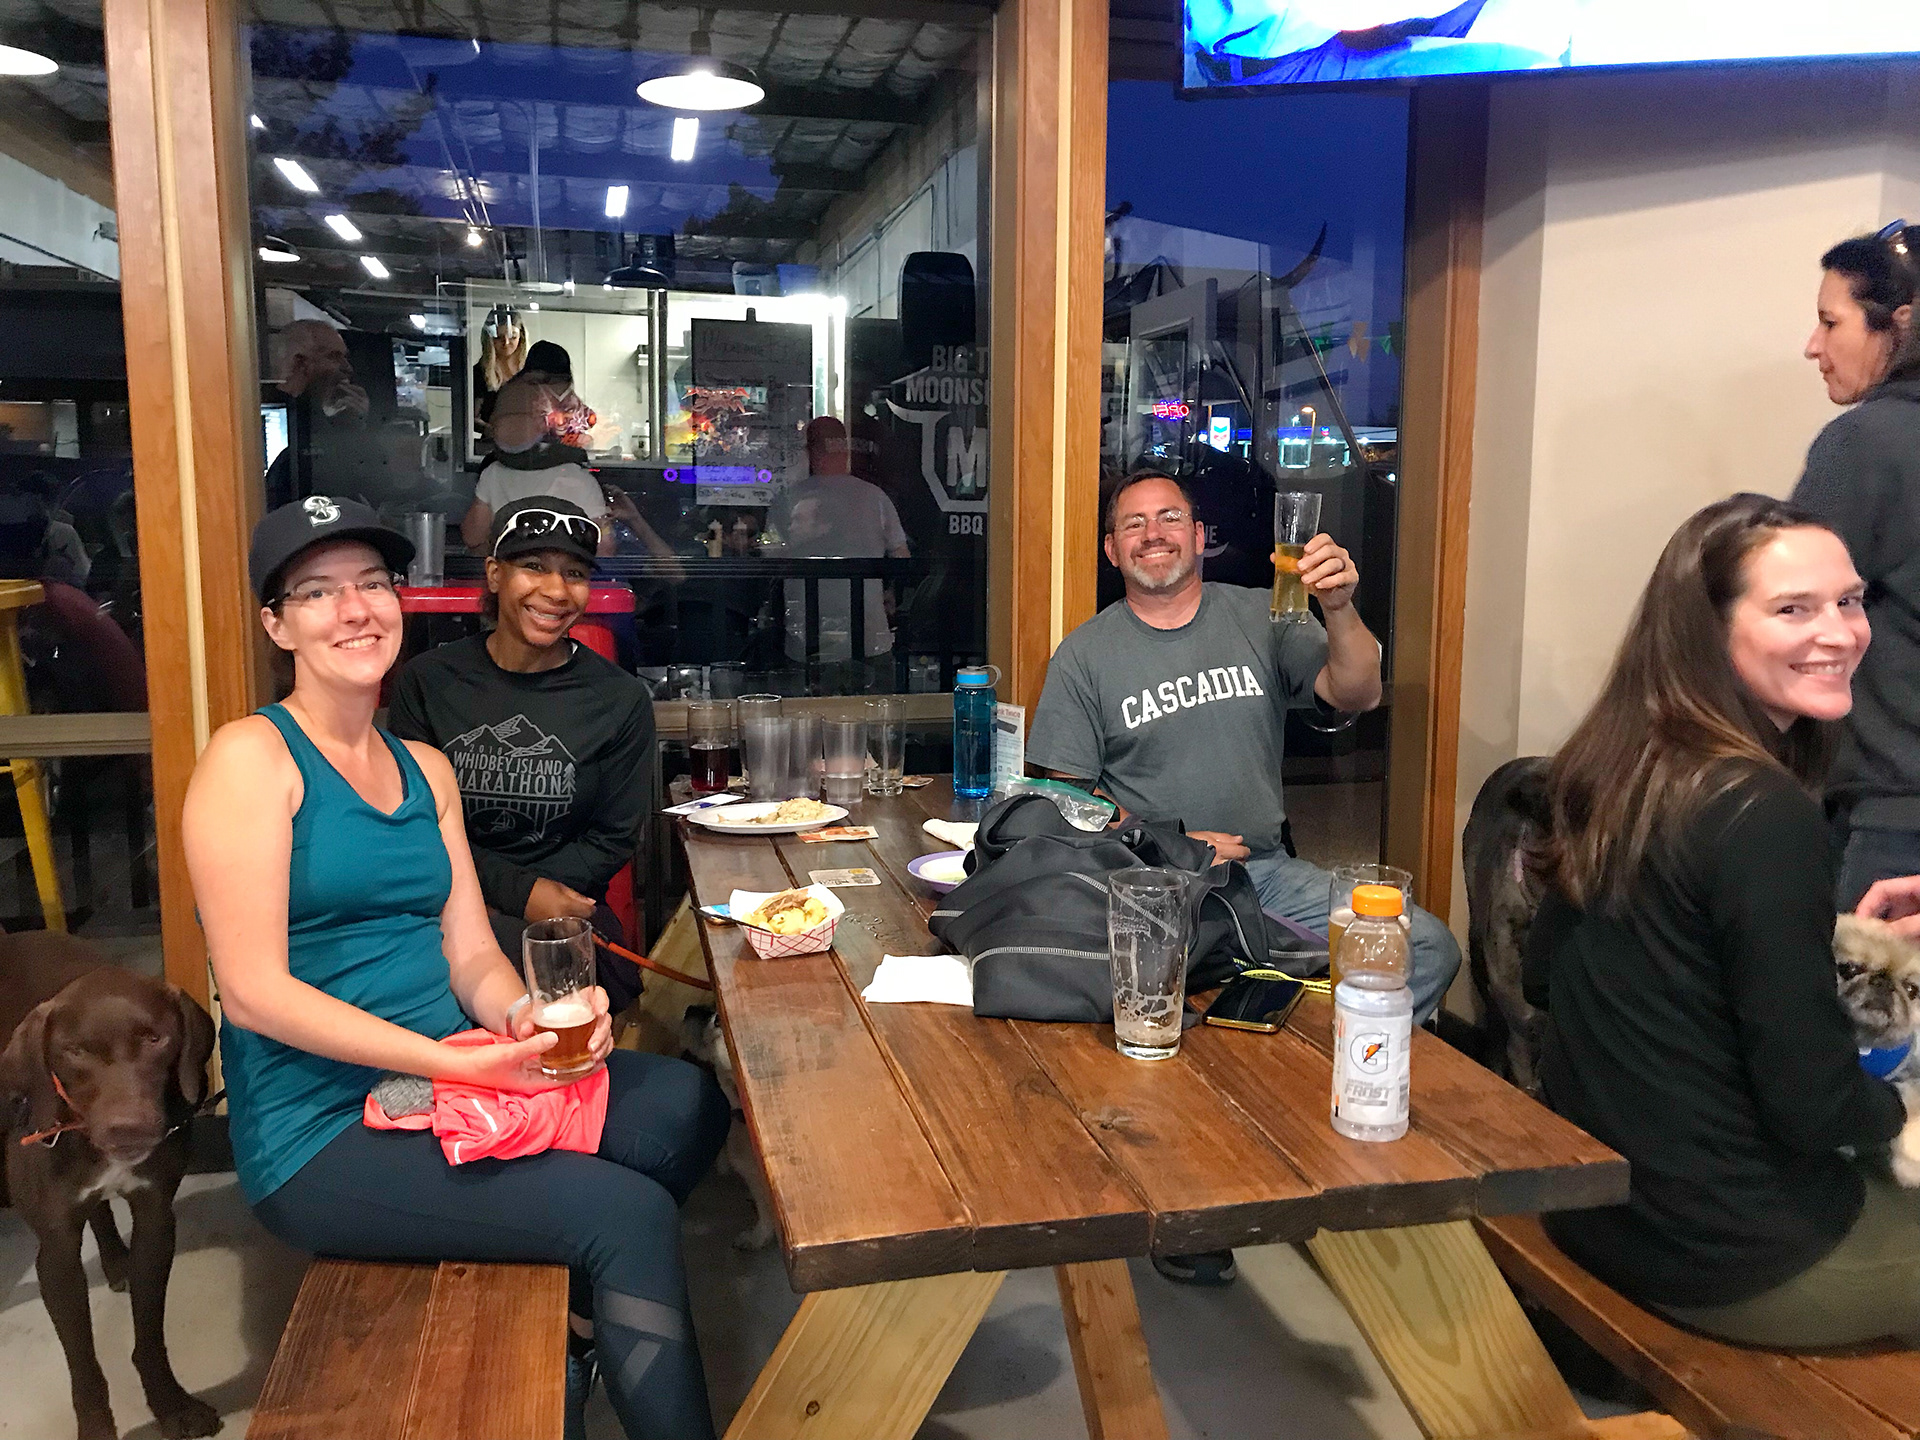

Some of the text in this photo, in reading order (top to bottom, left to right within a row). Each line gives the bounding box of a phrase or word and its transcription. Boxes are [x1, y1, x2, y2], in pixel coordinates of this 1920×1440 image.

[932, 345, 968, 373] BIG
[946, 426, 987, 488] M
[949, 515, 983, 536] BBQ
[1121, 665, 1264, 730] CASCADIA
[454, 750, 563, 776] WHIDBEY ISLAND
[469, 744, 503, 756] 2018
[1350, 1032, 1390, 1075] G
[1344, 1082, 1392, 1100] FROST
